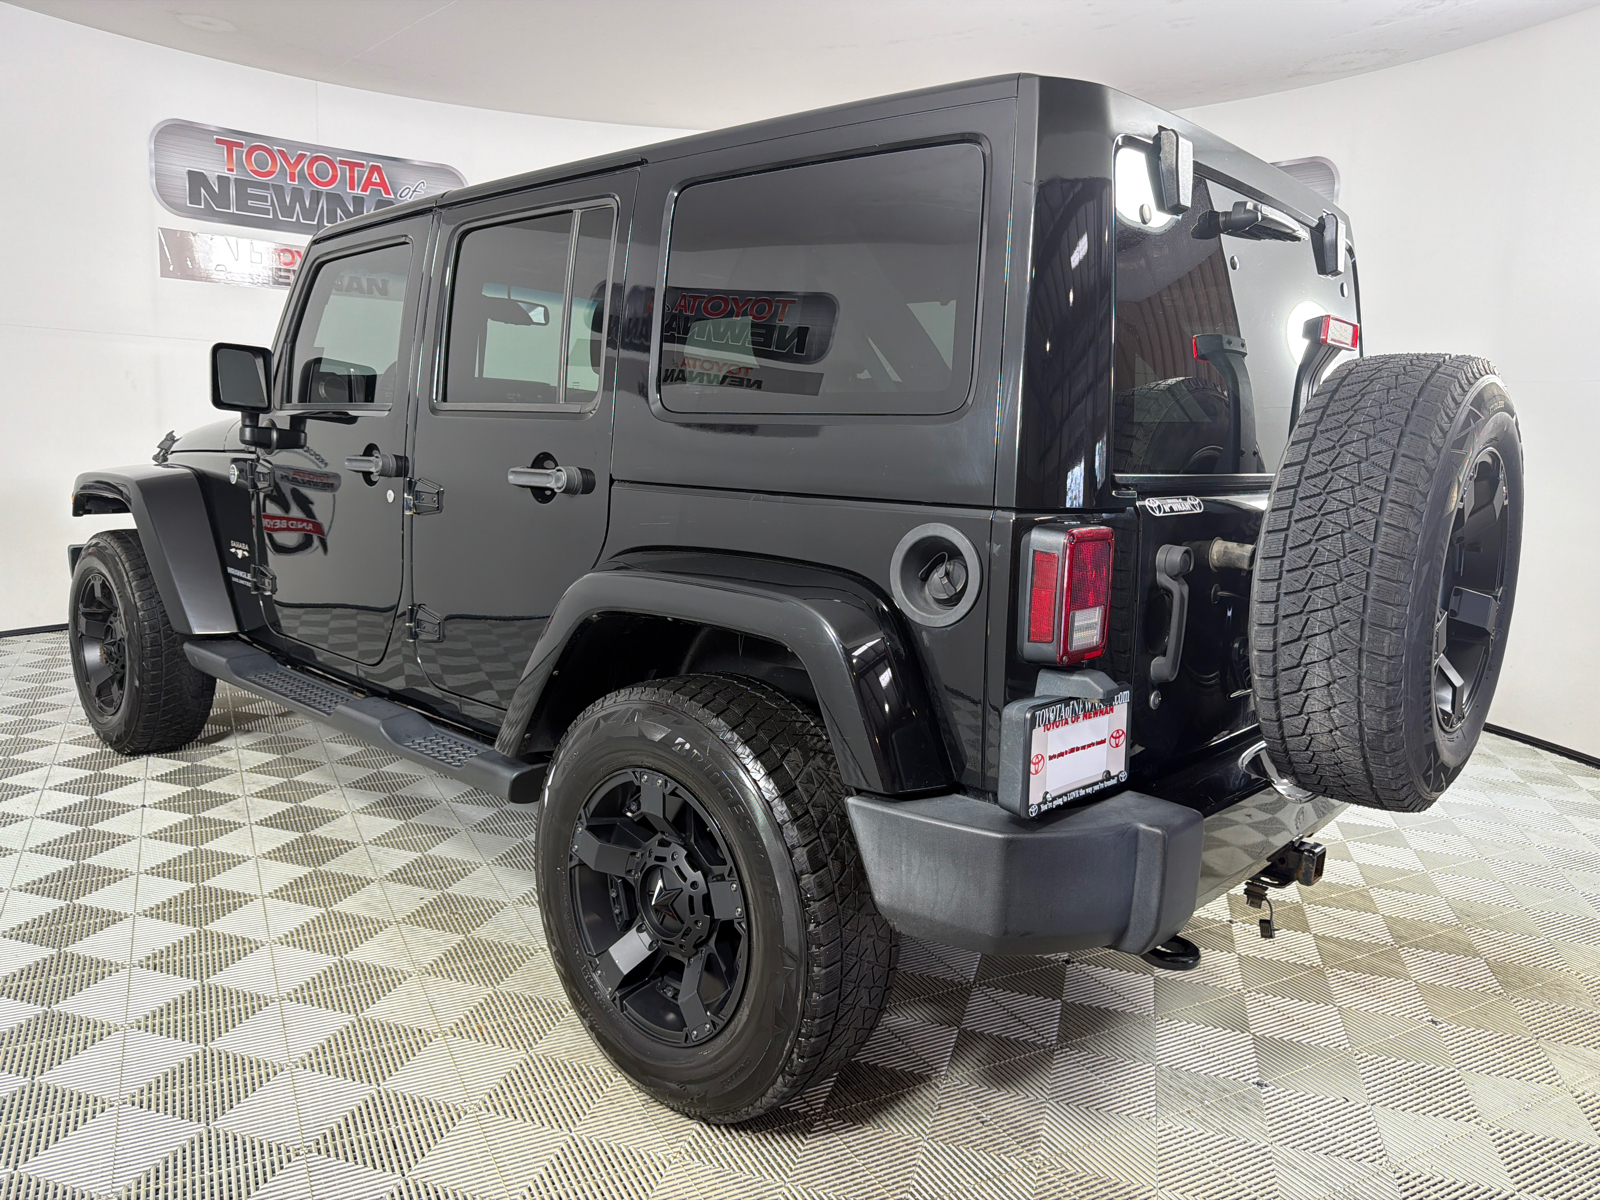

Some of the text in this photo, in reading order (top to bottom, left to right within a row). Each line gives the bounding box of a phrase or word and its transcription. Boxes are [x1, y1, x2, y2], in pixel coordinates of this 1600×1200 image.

[214, 136, 426, 201] TOYOTA of
[186, 169, 396, 226] NEWN
[226, 566, 252, 581] WRANGLE
[231, 576, 252, 588] UNLIMITE
